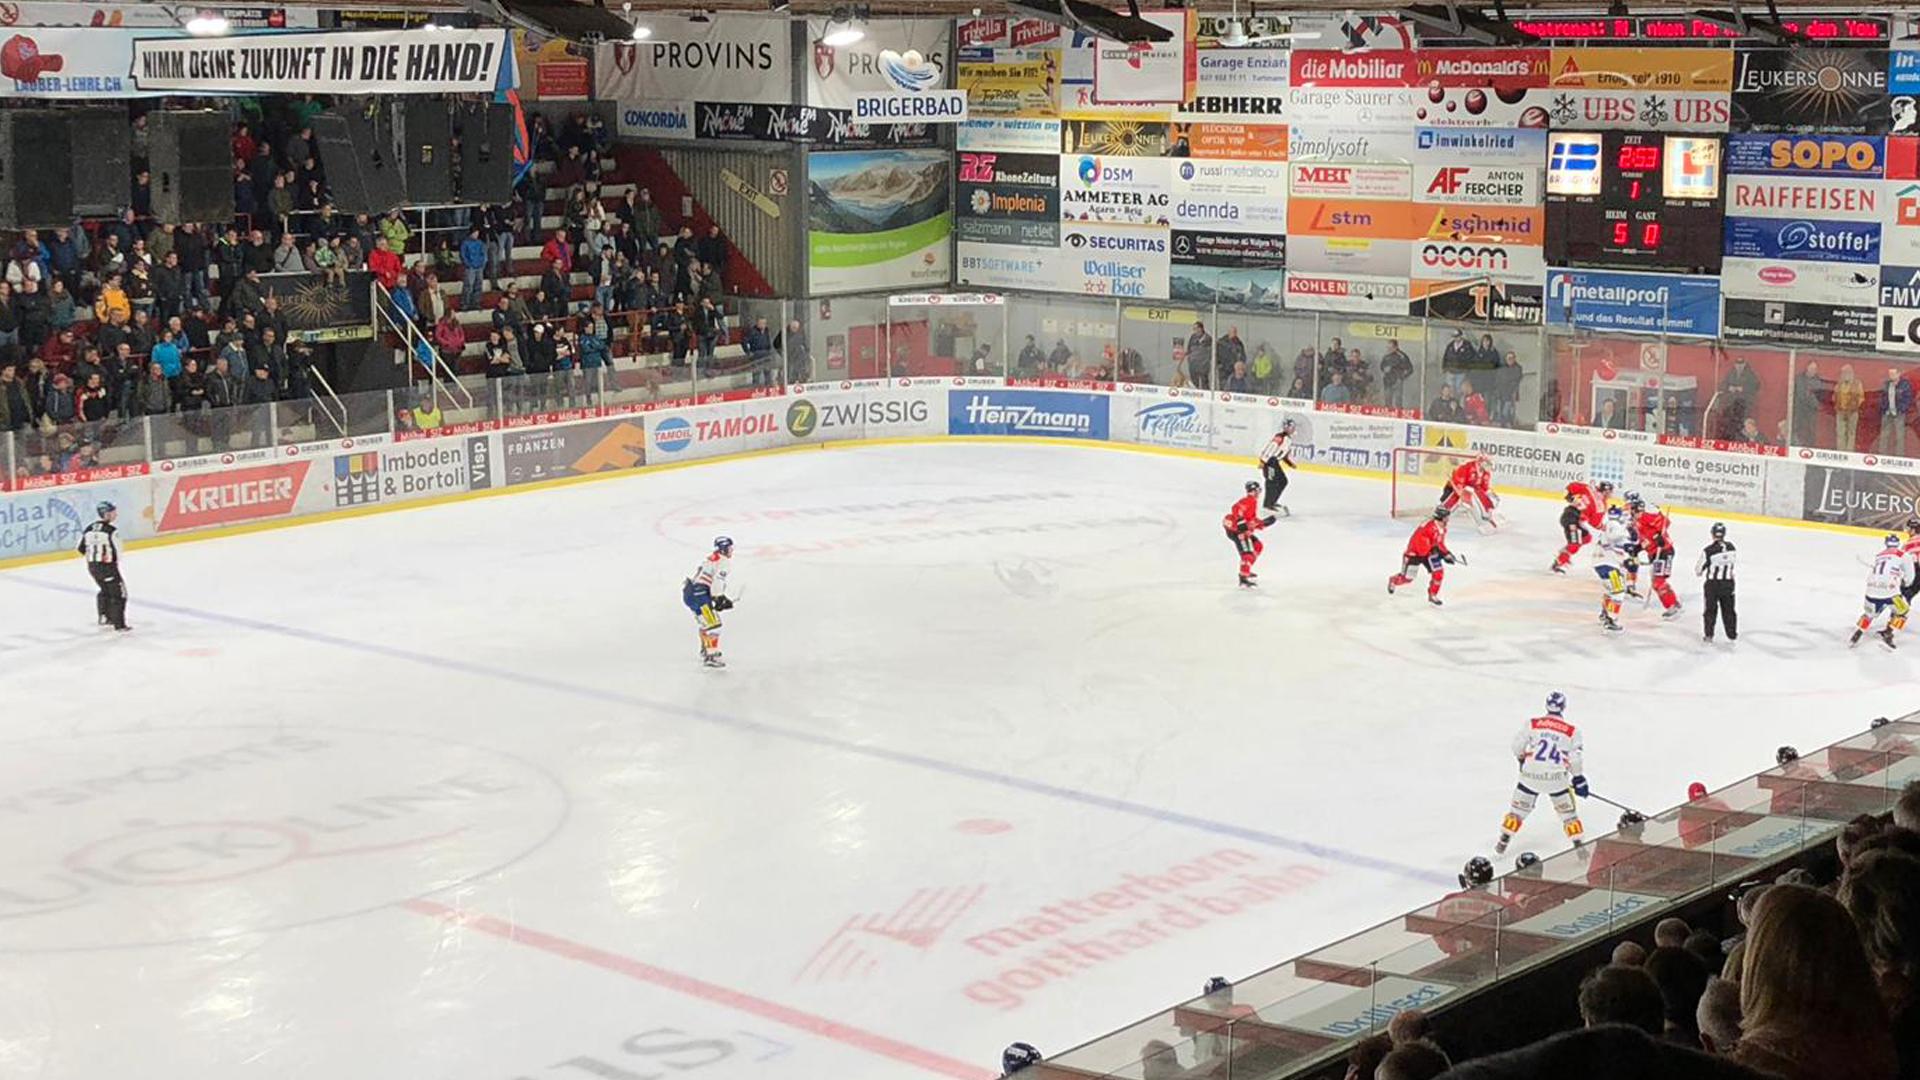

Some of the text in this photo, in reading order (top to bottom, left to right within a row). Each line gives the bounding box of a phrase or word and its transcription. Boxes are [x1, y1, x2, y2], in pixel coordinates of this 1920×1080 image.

[1017, 19, 1054, 42] rivella
[143, 42, 495, 81] NIMM DEINE ZUKUNFT IN DIE HAND!
[653, 42, 773, 70] PROVINS
[1103, 50, 1139, 59] Groupe
[1200, 57, 1287, 71] Garage Enzian
[1301, 58, 1404, 79] die Mobiliar
[1436, 60, 1529, 75] McDonald's
[857, 96, 963, 119] BRIGERBAD
[1290, 89, 1340, 108] Garage
[1344, 90, 1393, 105] Saurer
[1583, 97, 1636, 121] UBS
[1674, 98, 1729, 123] UBS
[624, 109, 688, 129] CONCORDIA
[1289, 137, 1368, 161] simplysoft
[1435, 134, 1514, 148] imwinkelried
[1624, 136, 1643, 144] ZEIT
[1619, 147, 1659, 169] 2:53
[1771, 140, 1875, 170] SOPO
[995, 171, 1057, 187] RhoneZeitung
[1103, 168, 1132, 180] DSM
[1297, 166, 1351, 183] MBT
[1427, 167, 1471, 194] AF
[1487, 171, 1524, 181] ANTON
[1063, 190, 1169, 206] AMMETER AG
[1465, 183, 1523, 196] FERCHER
[1631, 181, 1640, 200] 1
[1736, 185, 1875, 211] RAIFFEISEN
[992, 193, 1045, 215] Implenia
[1177, 199, 1239, 220] dennda
[1331, 211, 1371, 225] stm
[1452, 213, 1531, 233] schmid
[1605, 210, 1627, 220] HEIM
[1635, 211, 1657, 221] GAST
[963, 222, 1011, 236] salzmann
[1614, 223, 1628, 244] 5
[1643, 224, 1659, 245] 0
[1090, 235, 1165, 252] SECURITAS
[1809, 232, 1869, 251] stoffel
[1422, 244, 1508, 269] ocom
[1084, 260, 1146, 279] Walliser
[1111, 278, 1145, 296] Bote
[1572, 286, 1668, 306] metallprofi
[1148, 310, 1170, 320] EXIT
[1616, 314, 1654, 326] Resultat
[338, 327, 359, 337] EXIT
[1375, 326, 1400, 337] EXIT
[821, 400, 928, 428] ZWISSIG
[655, 430, 692, 442] TAMOIL
[696, 413, 779, 442] TAMOIL
[508, 438, 565, 455] FRANZEN
[1471, 442, 1585, 466] ANDEREGGEN AG
[382, 450, 461, 473] Imboden
[471, 442, 487, 482] Visp
[1635, 452, 1760, 478] Talente gesucht!
[1816, 452, 1848, 461] GRUBER
[1880, 458, 1914, 468] GRUBER
[384, 467, 465, 495] & Bortoli
[1535, 739, 1561, 764] 24
[963, 847, 1259, 957] matterhorn
